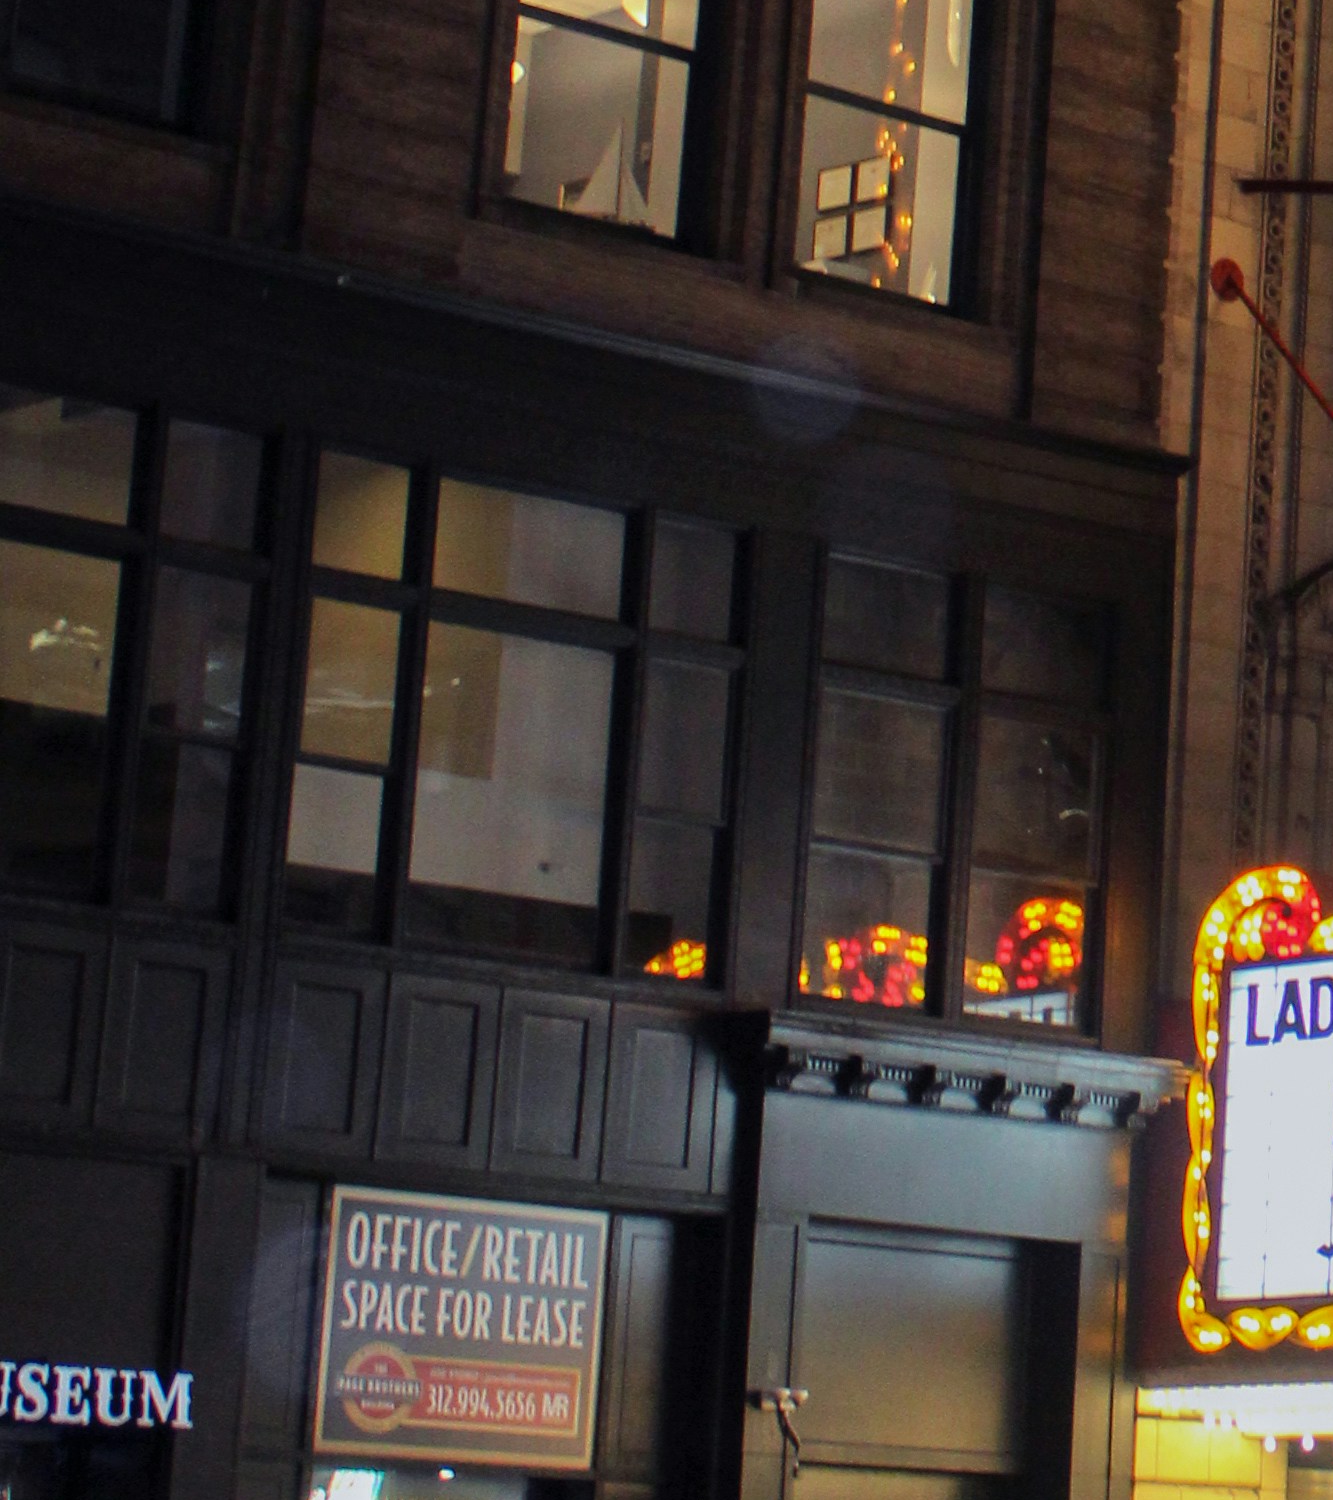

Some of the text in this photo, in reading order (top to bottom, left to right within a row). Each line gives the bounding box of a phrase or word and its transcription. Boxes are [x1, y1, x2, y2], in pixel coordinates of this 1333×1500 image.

[346, 1210, 589, 1290] OFFICE/RETAIL
[339, 1278, 587, 1349] SPACE FOR LEASE
[426, 1384, 536, 1422] 312.994.5656
